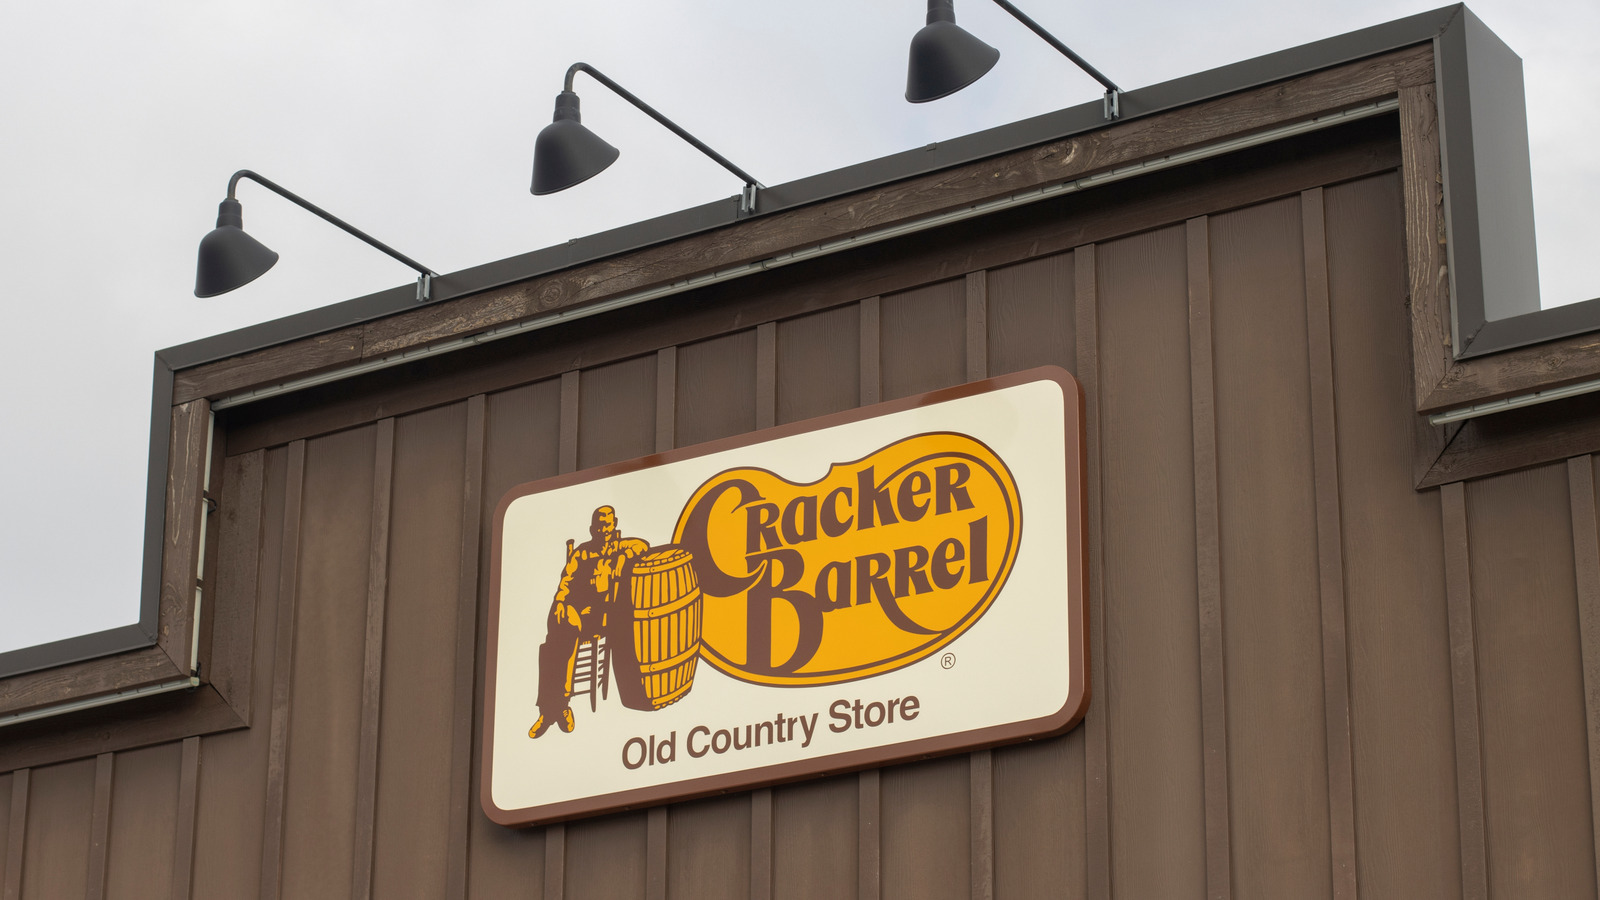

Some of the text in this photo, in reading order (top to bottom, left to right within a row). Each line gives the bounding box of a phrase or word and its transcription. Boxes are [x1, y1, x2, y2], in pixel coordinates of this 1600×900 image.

[621, 695, 921, 770] Old Country Store
